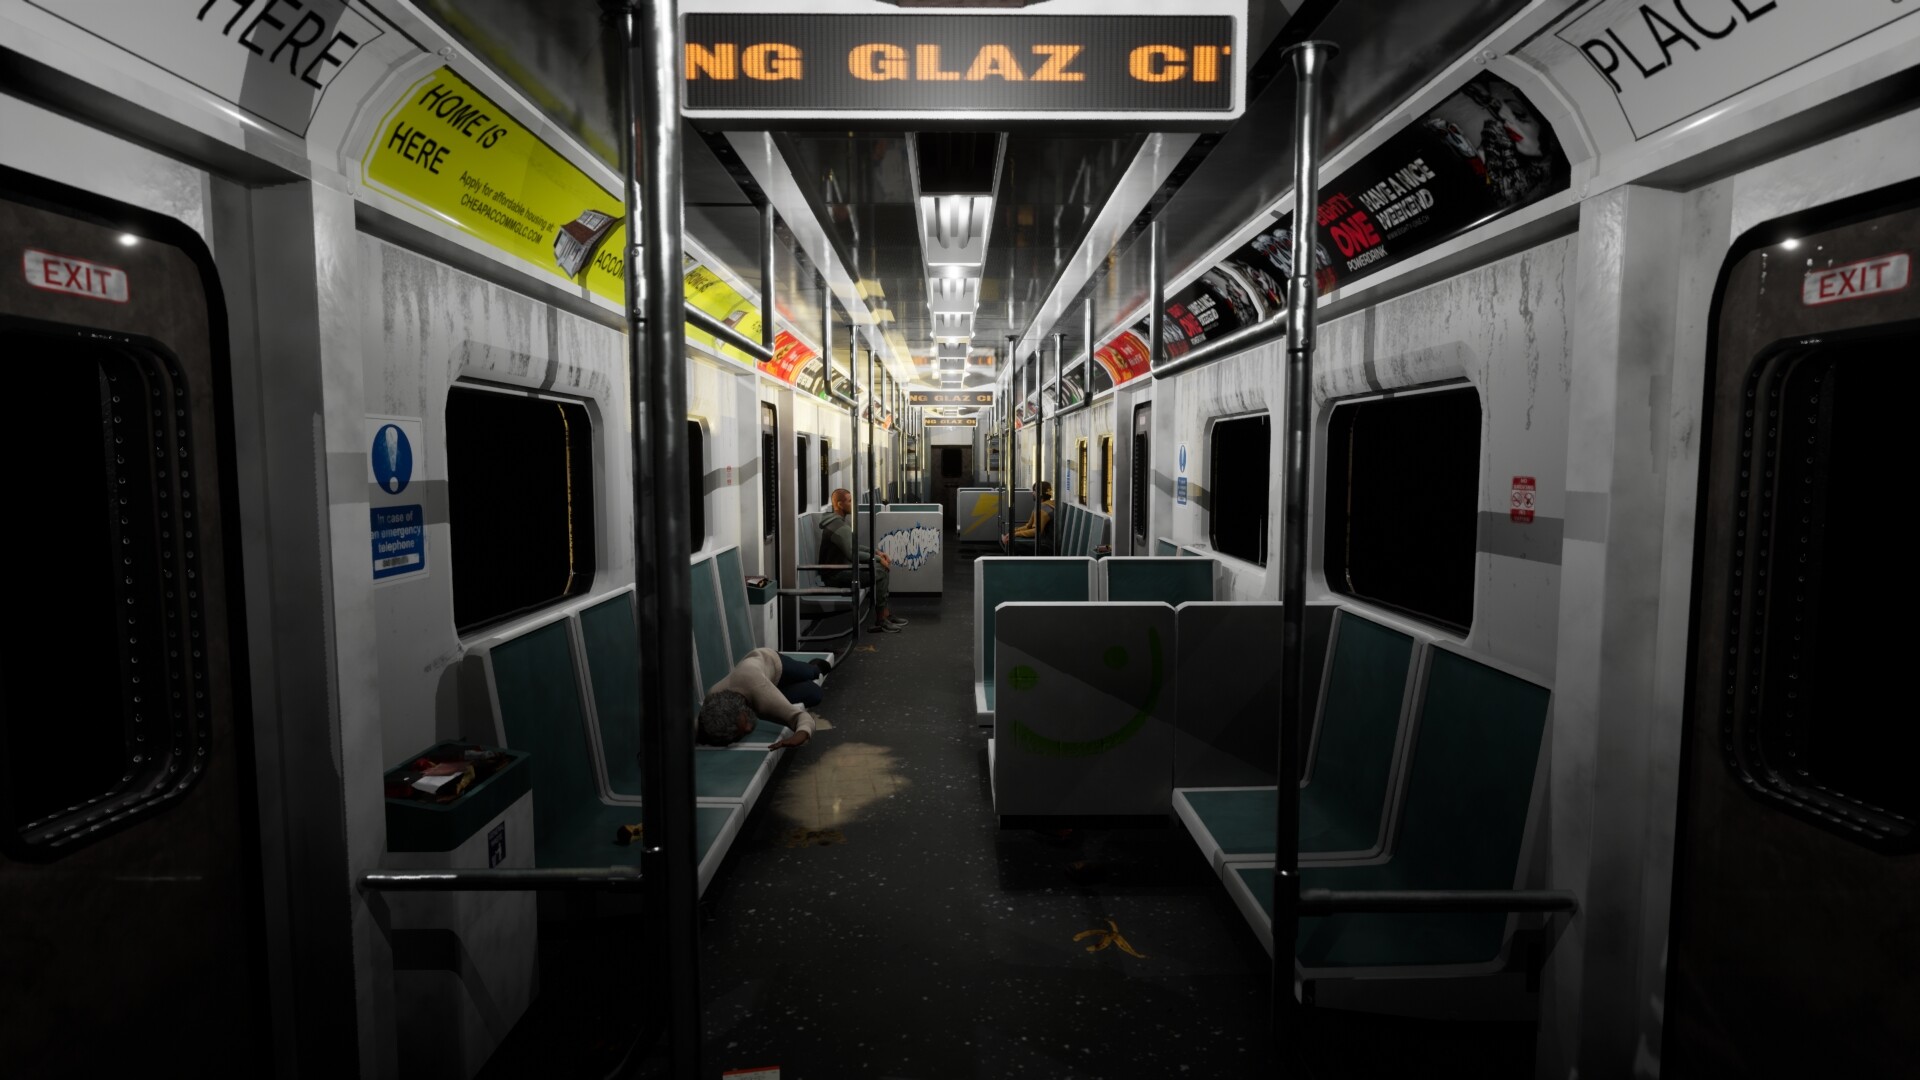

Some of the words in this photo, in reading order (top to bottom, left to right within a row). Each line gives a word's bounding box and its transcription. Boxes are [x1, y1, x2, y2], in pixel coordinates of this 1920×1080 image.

[848, 43, 1086, 81] GLAZ
[1129, 44, 1232, 83] CI
[418, 83, 490, 138] HOME
[476, 124, 507, 149] IS
[388, 121, 450, 175] HERE
[1386, 176, 1408, 197] A
[1394, 157, 1437, 191] NICE
[459, 170, 483, 194] Apply
[481, 182, 494, 197] for
[492, 191, 526, 216] affordable
[524, 208, 549, 231] housing
[1358, 181, 1398, 213] HAVE
[1375, 188, 1435, 231] WEEKEND
[460, 193, 543, 244] CHEAPACCOMMGLC.COM
[1330, 210, 1382, 258] ONE
[43, 258, 112, 295] EXIT
[1346, 244, 1389, 272] POWERDRINK
[1819, 261, 1891, 299] EXIT
[934, 394, 971, 402] GLAZ
[976, 394, 993, 402] CI
[377, 513, 385, 524] In
[386, 513, 404, 524] case
[405, 510, 414, 521] of
[381, 524, 421, 539] emergency
[378, 539, 415, 553] telephone
